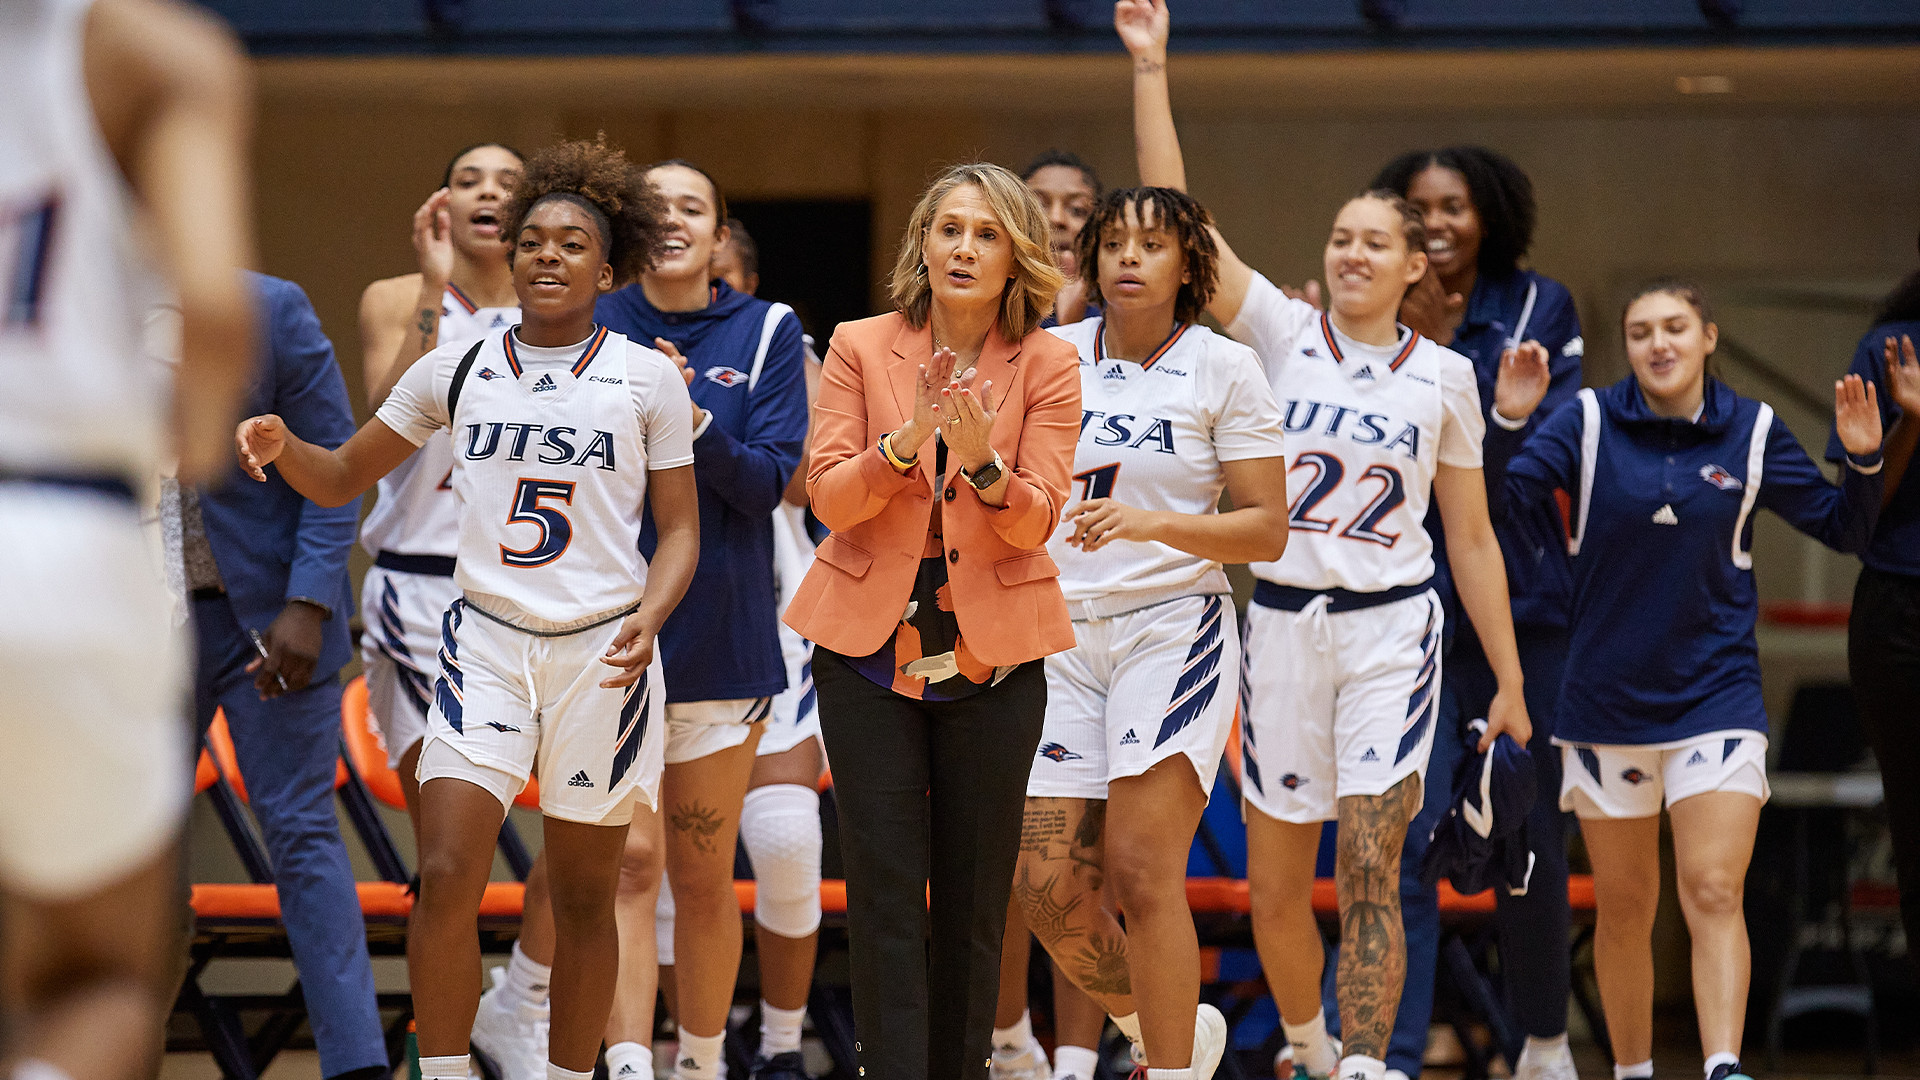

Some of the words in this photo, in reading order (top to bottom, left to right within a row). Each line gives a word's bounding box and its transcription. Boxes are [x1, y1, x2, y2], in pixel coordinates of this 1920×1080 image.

[532, 384, 557, 392] adidas
[464, 422, 617, 472] UTSA
[1079, 409, 1176, 455] TSA
[1283, 400, 1420, 462] UTSA
[498, 477, 577, 569] 5
[1287, 451, 1406, 549] 22
[567, 780, 594, 788] adidas
